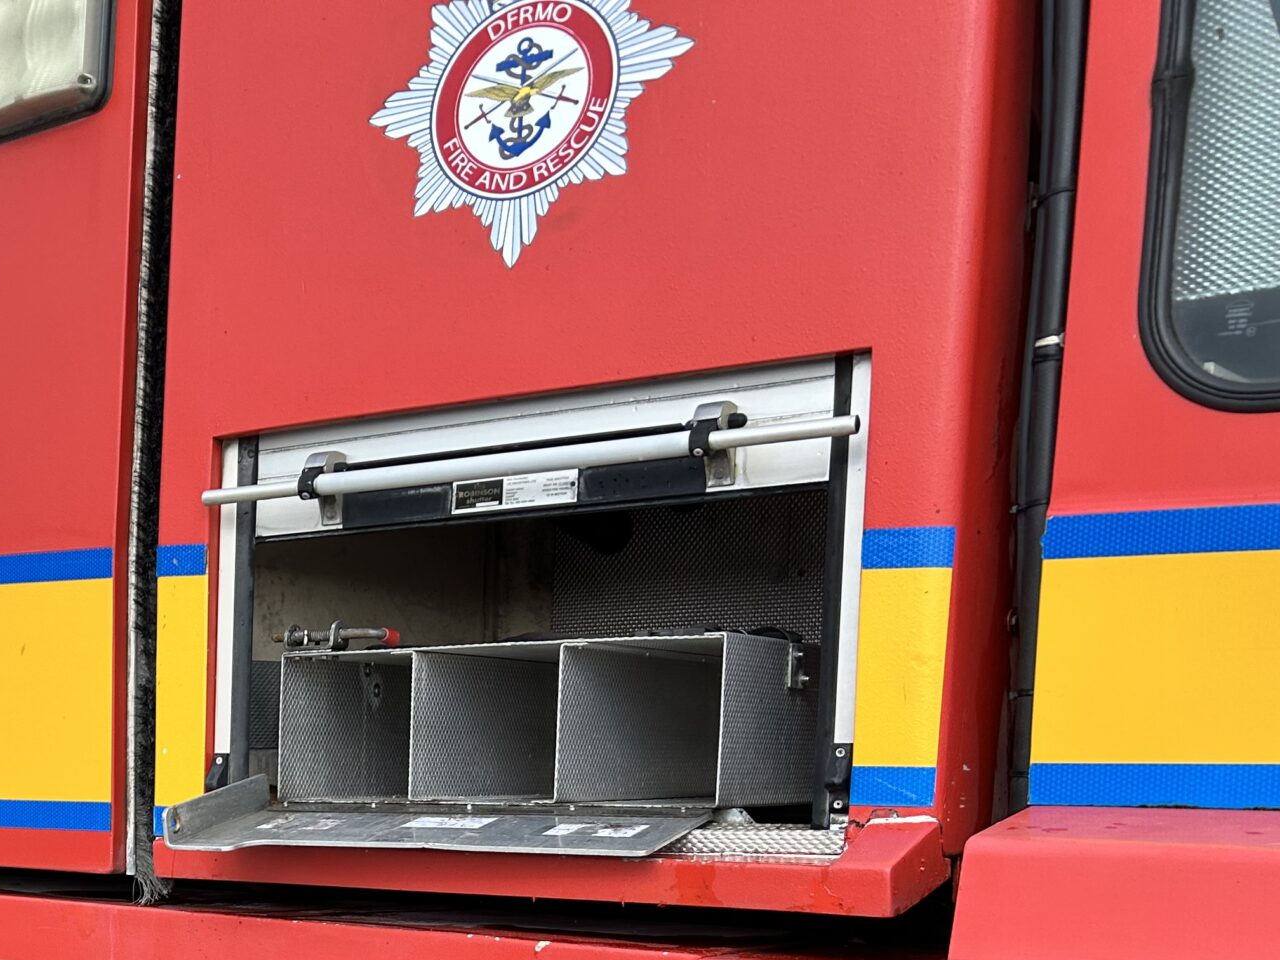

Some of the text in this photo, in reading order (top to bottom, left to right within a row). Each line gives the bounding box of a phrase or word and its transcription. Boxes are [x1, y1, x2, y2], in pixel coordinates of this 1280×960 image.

[486, 3, 572, 41] DFRMO
[443, 97, 608, 191] FIRE AND RESCUE
